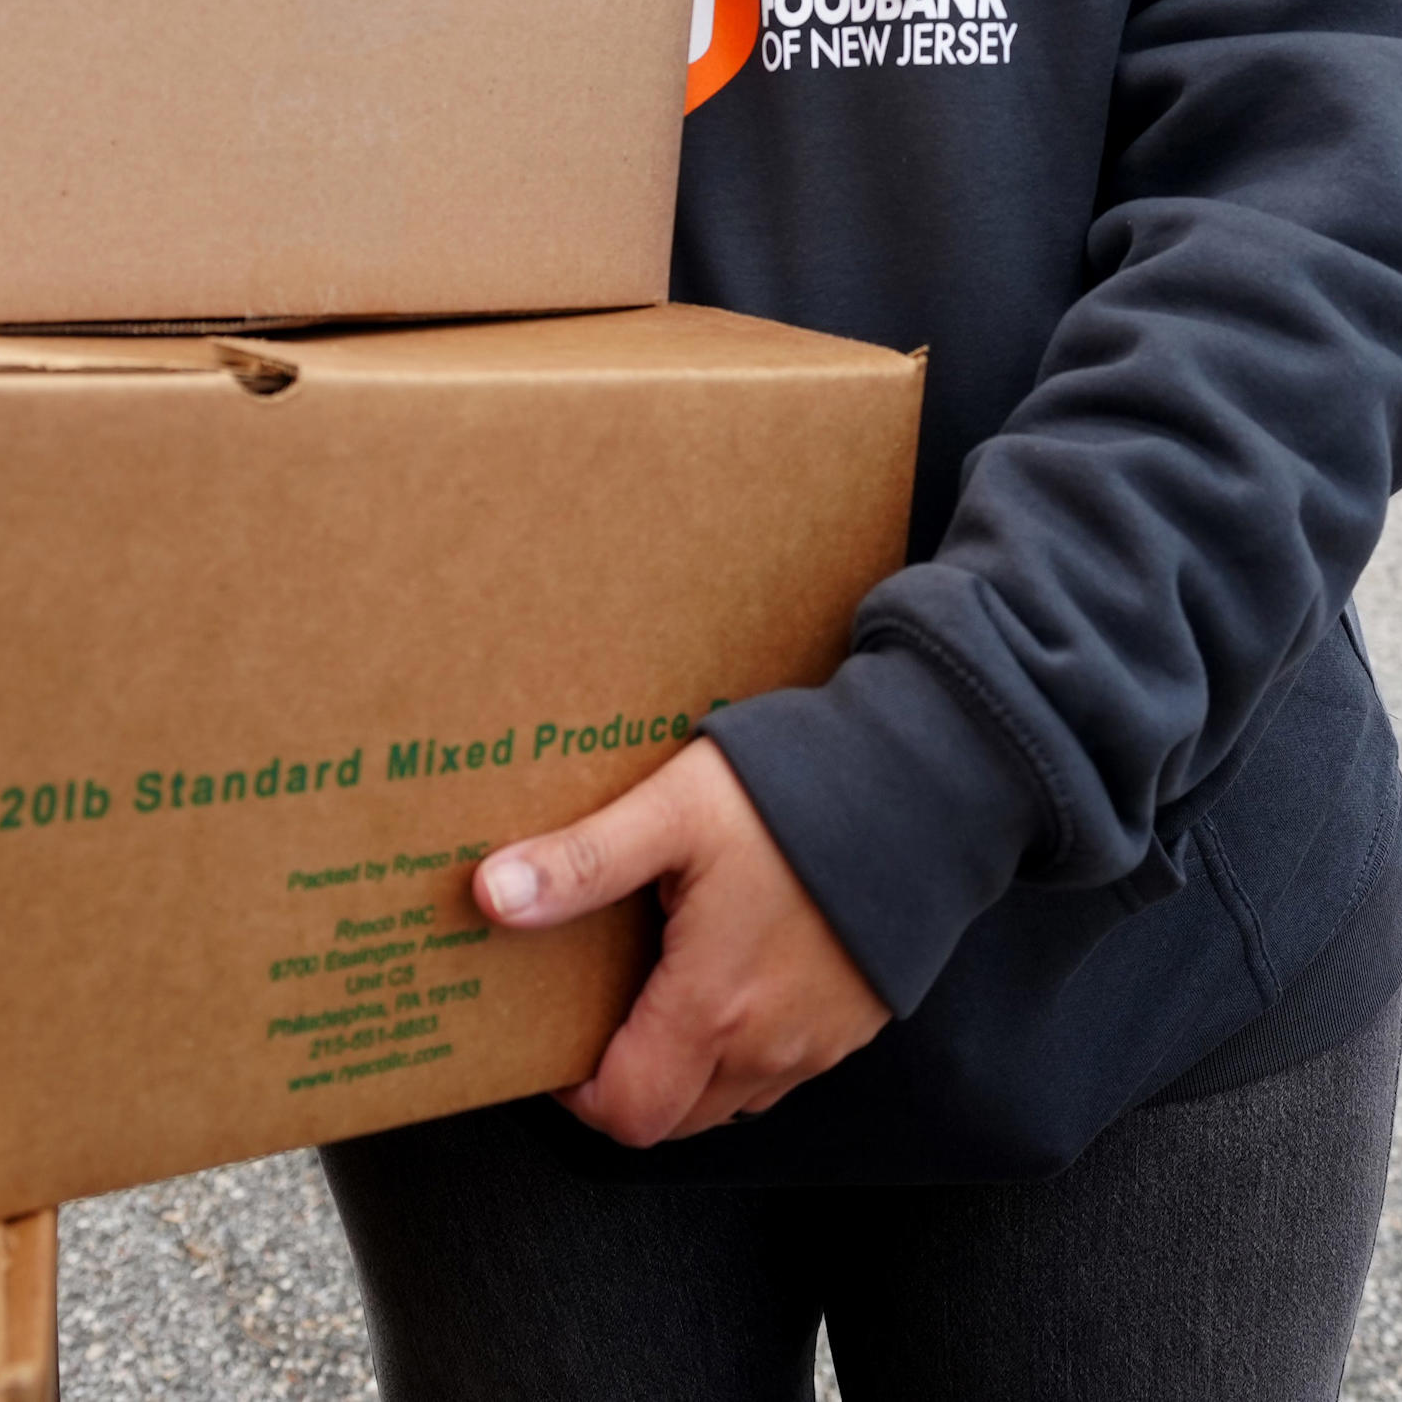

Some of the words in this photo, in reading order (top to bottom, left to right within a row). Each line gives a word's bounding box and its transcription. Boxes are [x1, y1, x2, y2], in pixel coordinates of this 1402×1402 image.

[761, 29, 802, 73] OF
[810, 24, 892, 70] NEW
[896, 22, 1019, 67] JERSEY
[133, 747, 362, 813] Standard
[387, 727, 515, 781] Mixed
[531, 711, 690, 760] Produce
[287, 863, 362, 892] Packed
[365, 860, 386, 882] by
[400, 904, 435, 929] INC
[421, 927, 490, 951] Avenue
[345, 972, 384, 995] Unit
[395, 992, 421, 1014] PA
